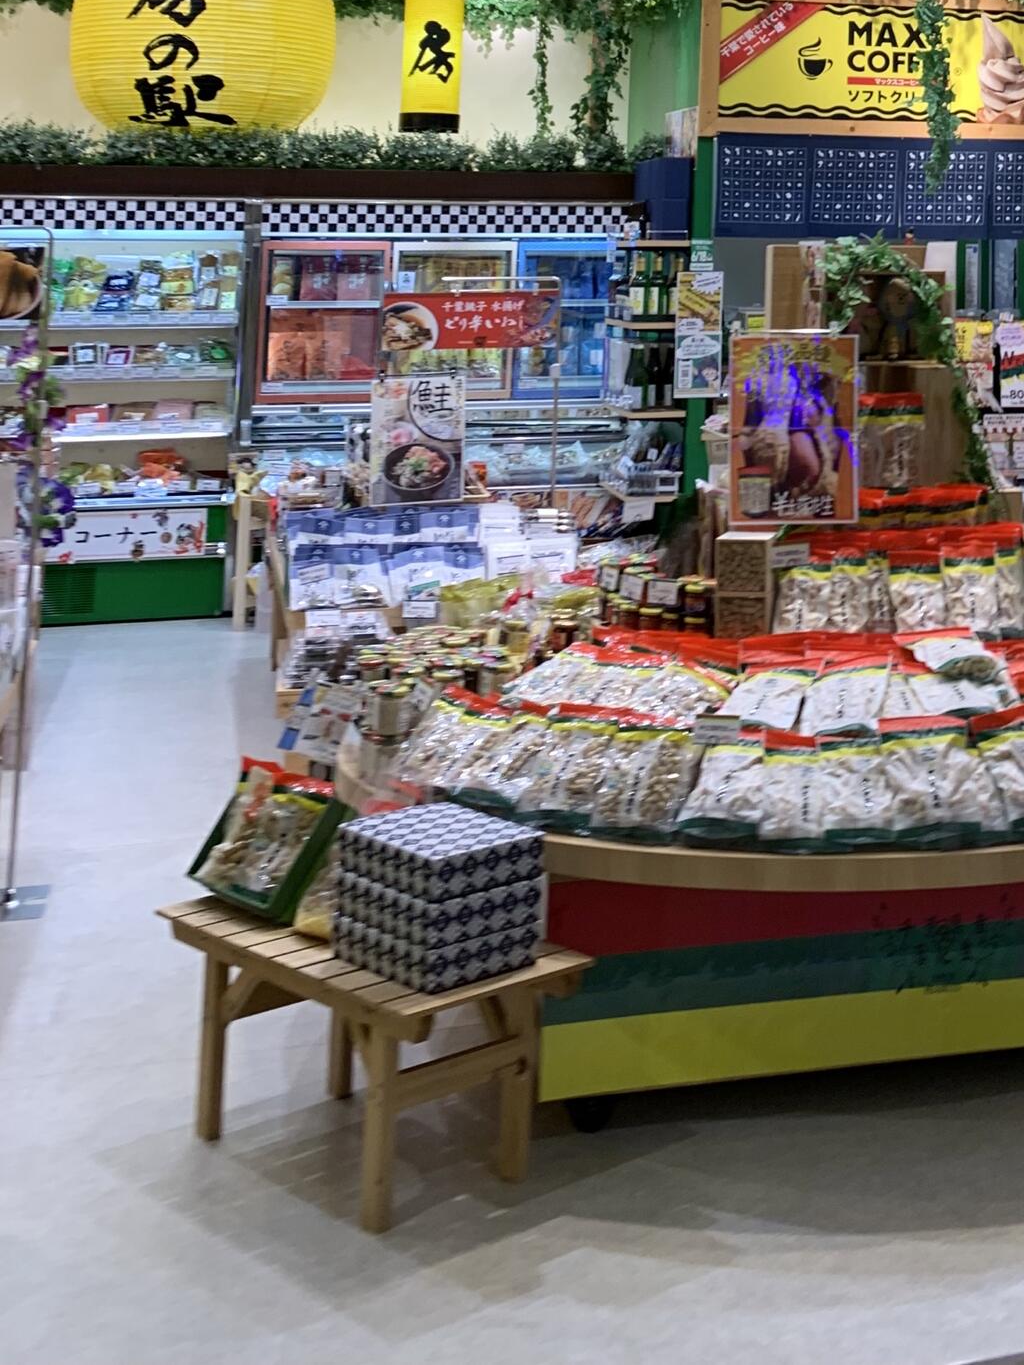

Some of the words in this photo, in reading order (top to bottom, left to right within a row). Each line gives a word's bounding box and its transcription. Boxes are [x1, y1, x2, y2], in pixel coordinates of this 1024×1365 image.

[848, 21, 927, 49] MAX
[408, 20, 456, 83] 房
[411, 380, 454, 415] 鮭
[75, 527, 157, 544] コーナー
